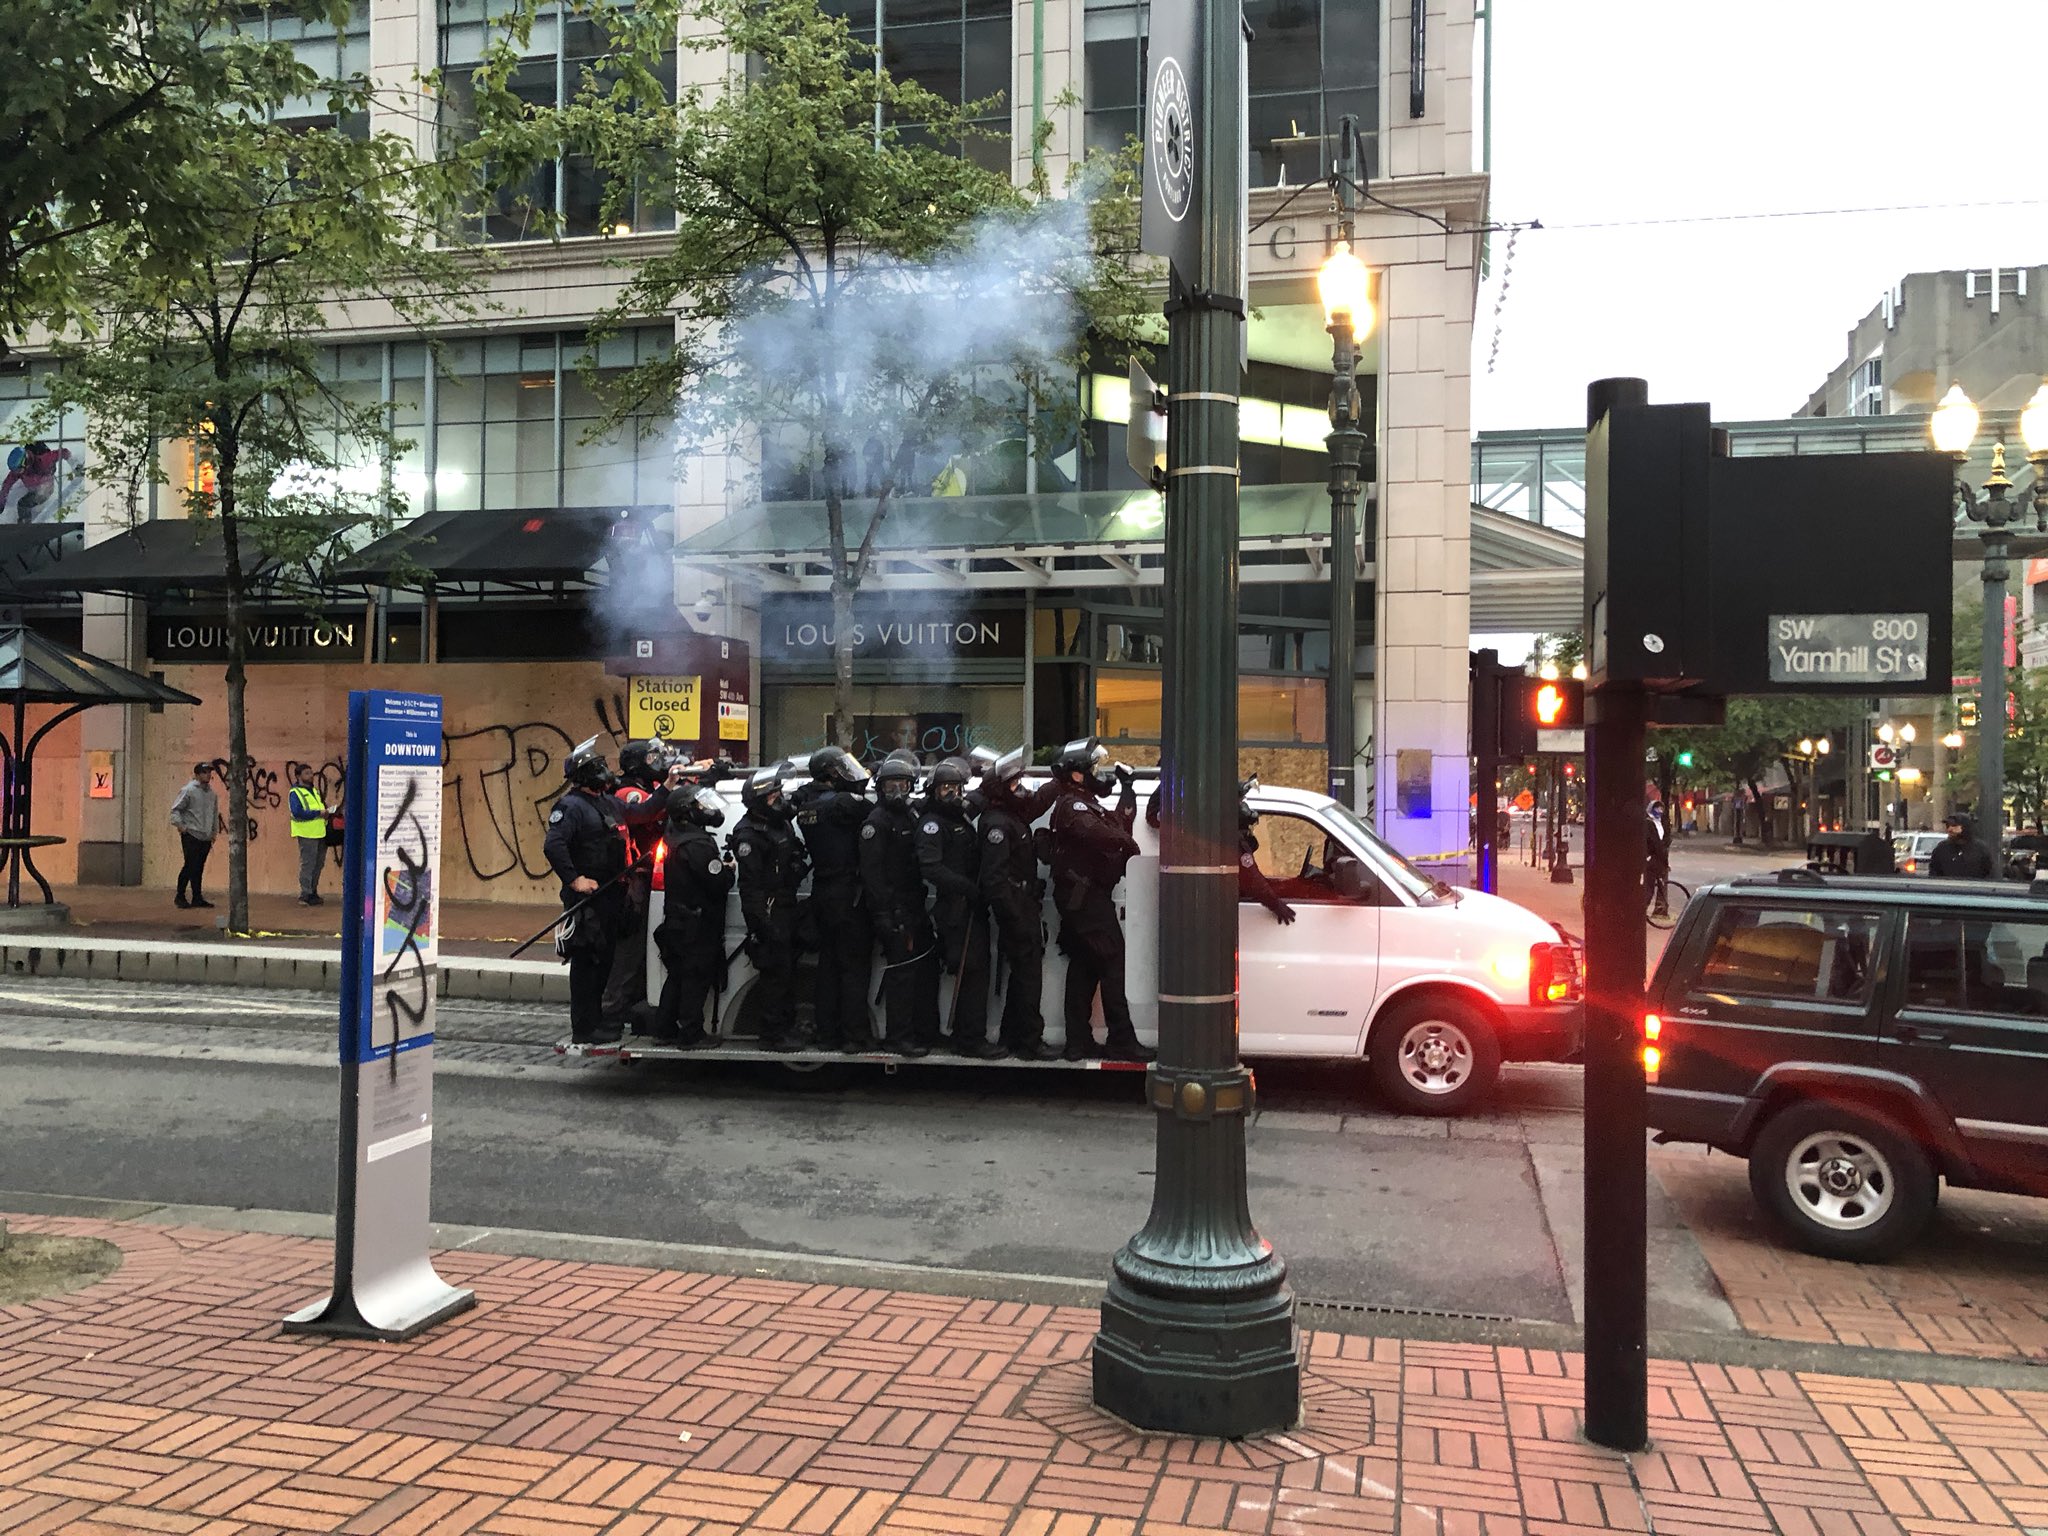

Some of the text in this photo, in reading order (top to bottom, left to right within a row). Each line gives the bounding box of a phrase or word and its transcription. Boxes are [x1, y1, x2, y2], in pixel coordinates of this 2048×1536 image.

[1155, 69, 1191, 183] PIONEER DISTRICT
[247, 624, 353, 647] VUITTON
[786, 622, 1000, 646] LOUS VUITTON
[1778, 619, 1918, 641] SW 800
[1779, 645, 1903, 673] Yamhill St
[636, 679, 694, 693] Station
[639, 697, 691, 712] Closed
[385, 743, 436, 757] DOWNTOWN
